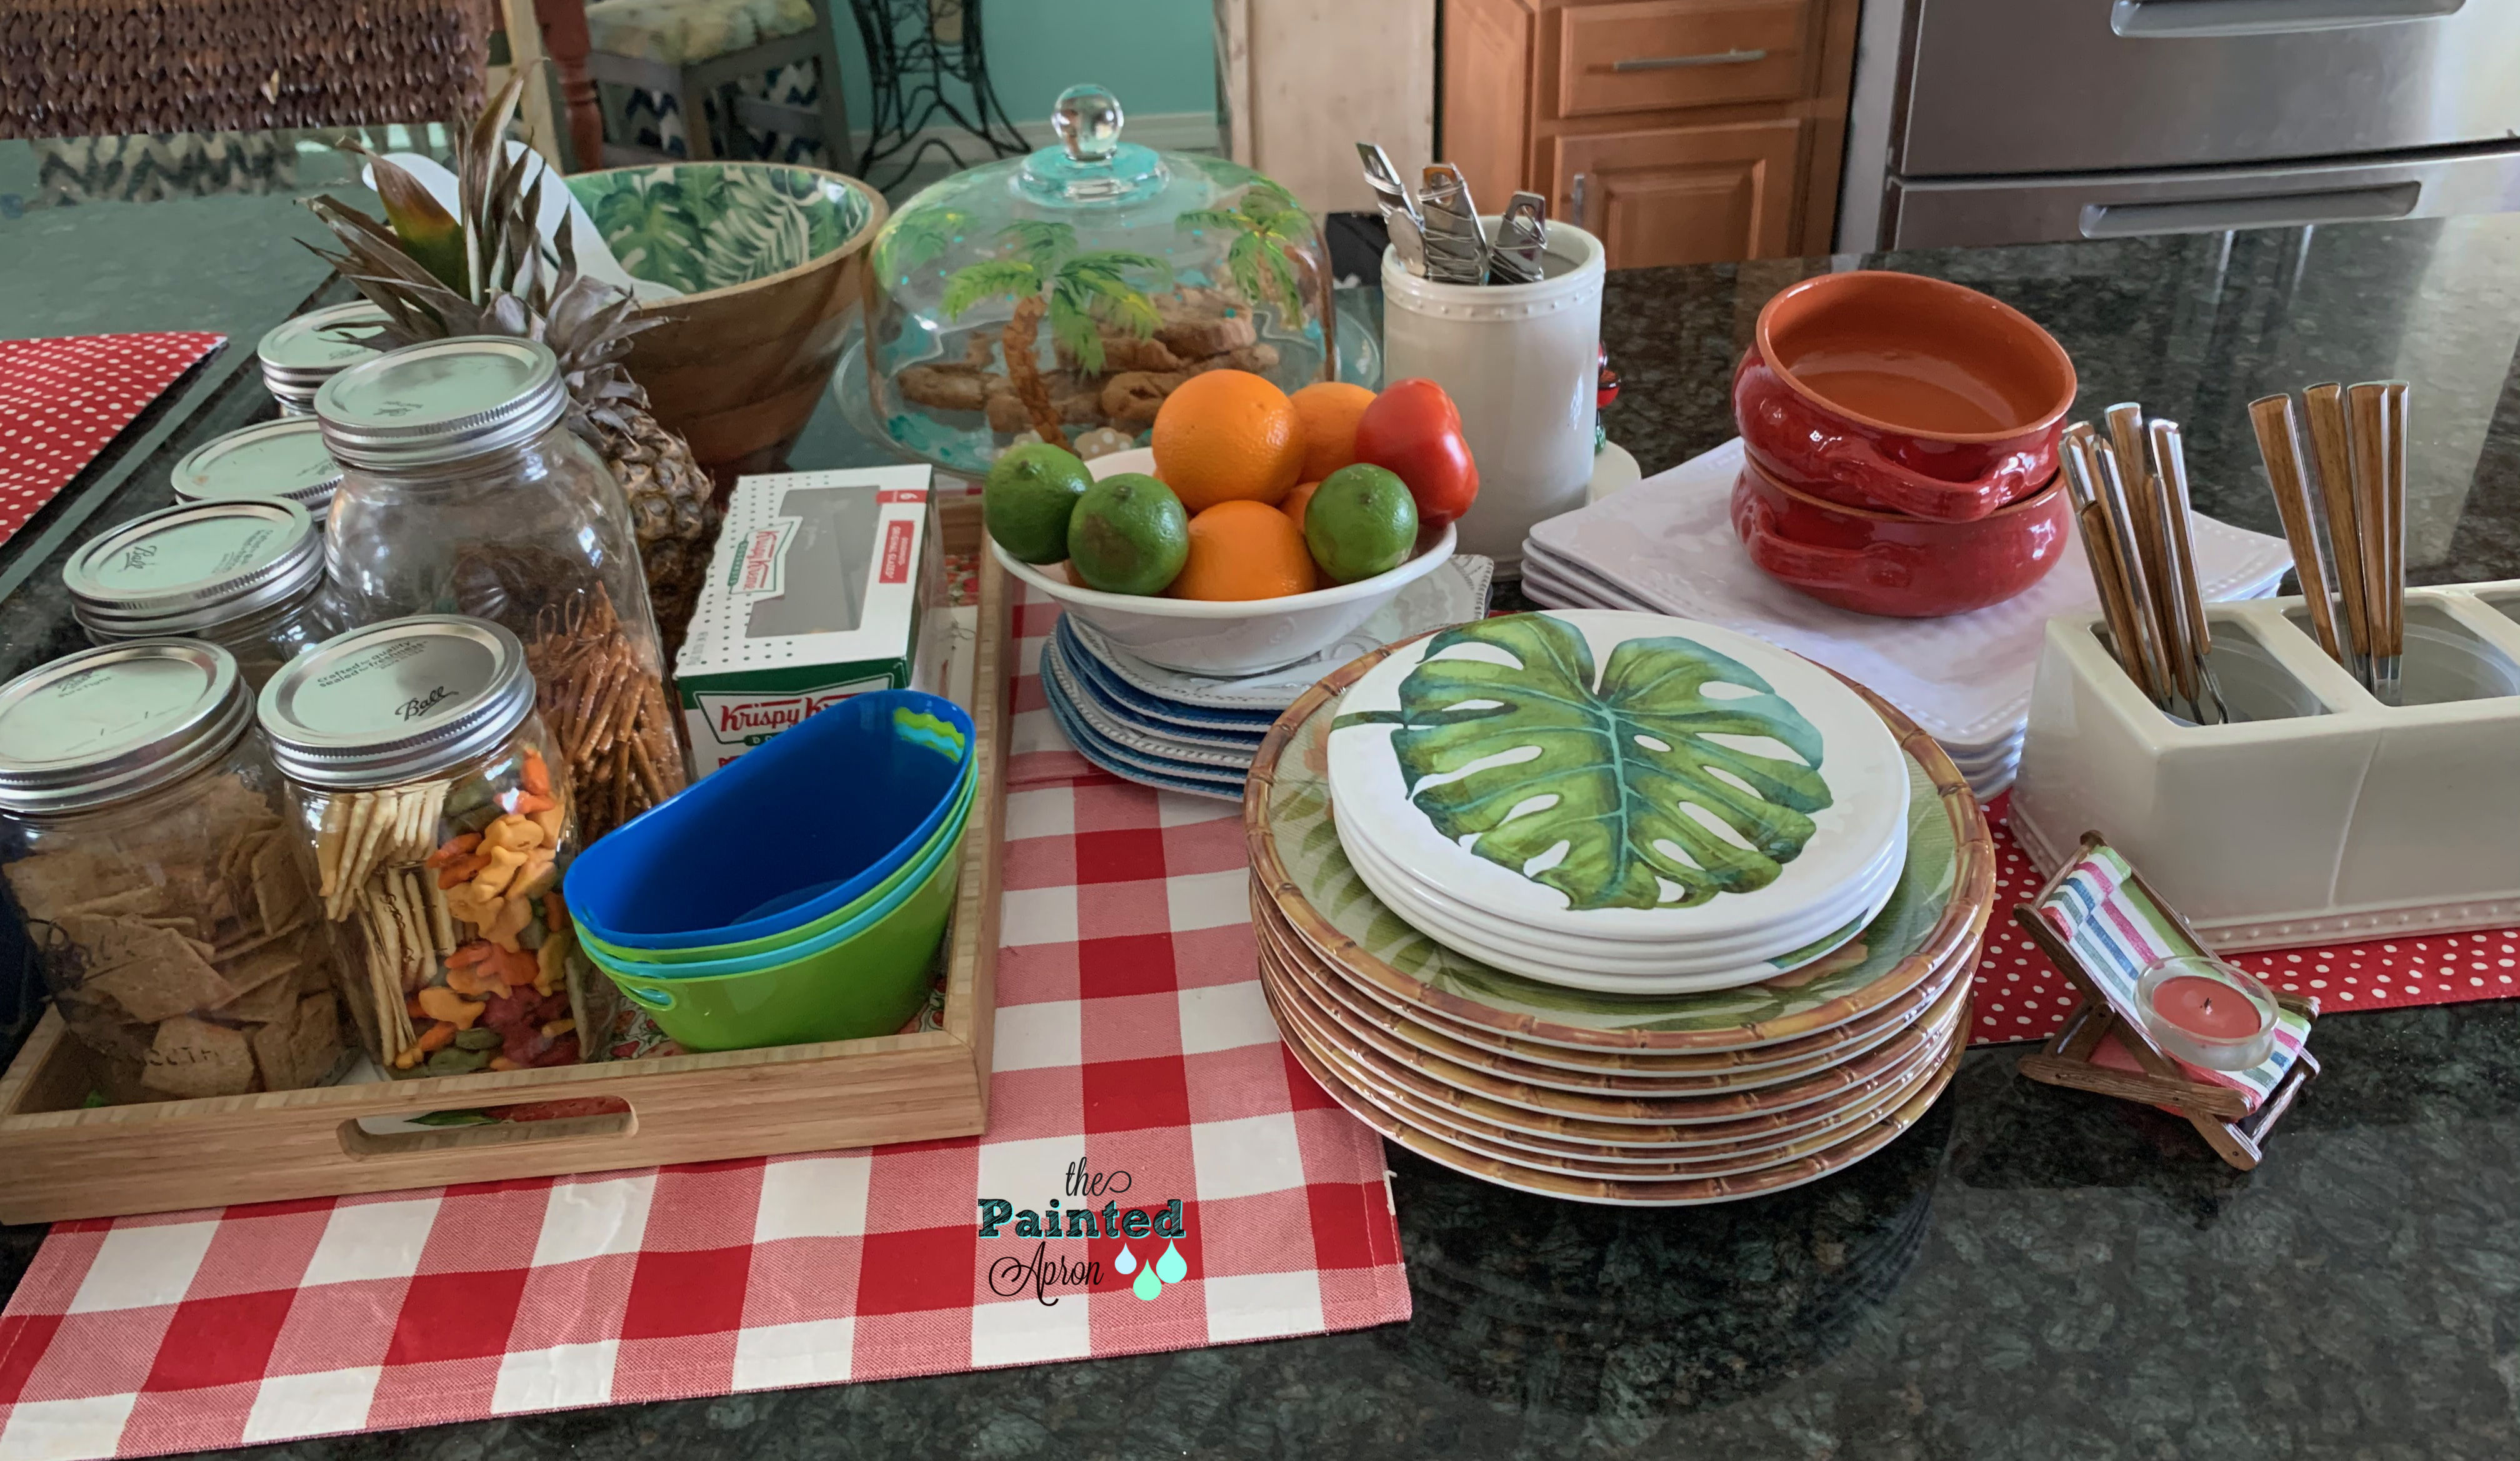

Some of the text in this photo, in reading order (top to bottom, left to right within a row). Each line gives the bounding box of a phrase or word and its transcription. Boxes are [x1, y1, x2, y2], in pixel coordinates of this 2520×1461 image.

[900, 492, 918, 500] 6
[117, 545, 158, 572] Ball
[318, 663, 361, 682] crafted
[371, 641, 411, 661] quality
[319, 670, 359, 687] sealed
[394, 686, 459, 721] Ball
[720, 698, 802, 731] Krispy
